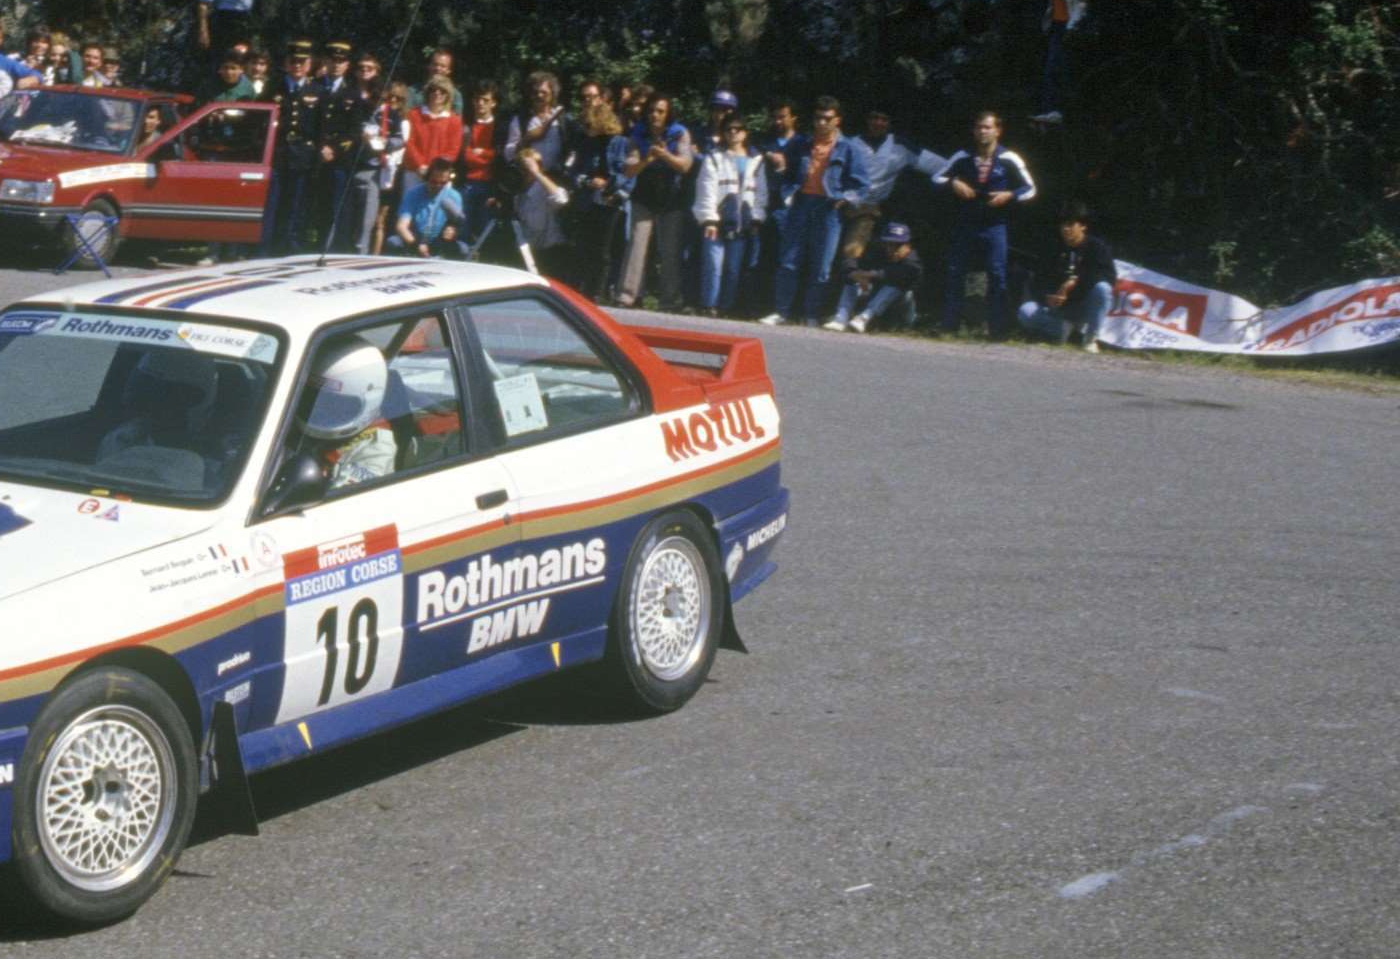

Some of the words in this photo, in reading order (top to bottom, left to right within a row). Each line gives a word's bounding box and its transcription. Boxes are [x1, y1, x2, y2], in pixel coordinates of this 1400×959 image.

[61, 318, 174, 341] Rothmans
[660, 399, 765, 463] MOTUL
[290, 568, 347, 601] REGION
[351, 553, 398, 583] CORSE
[416, 537, 606, 623] Rothmans
[316, 597, 379, 707] 10
[466, 599, 551, 654] BMW
